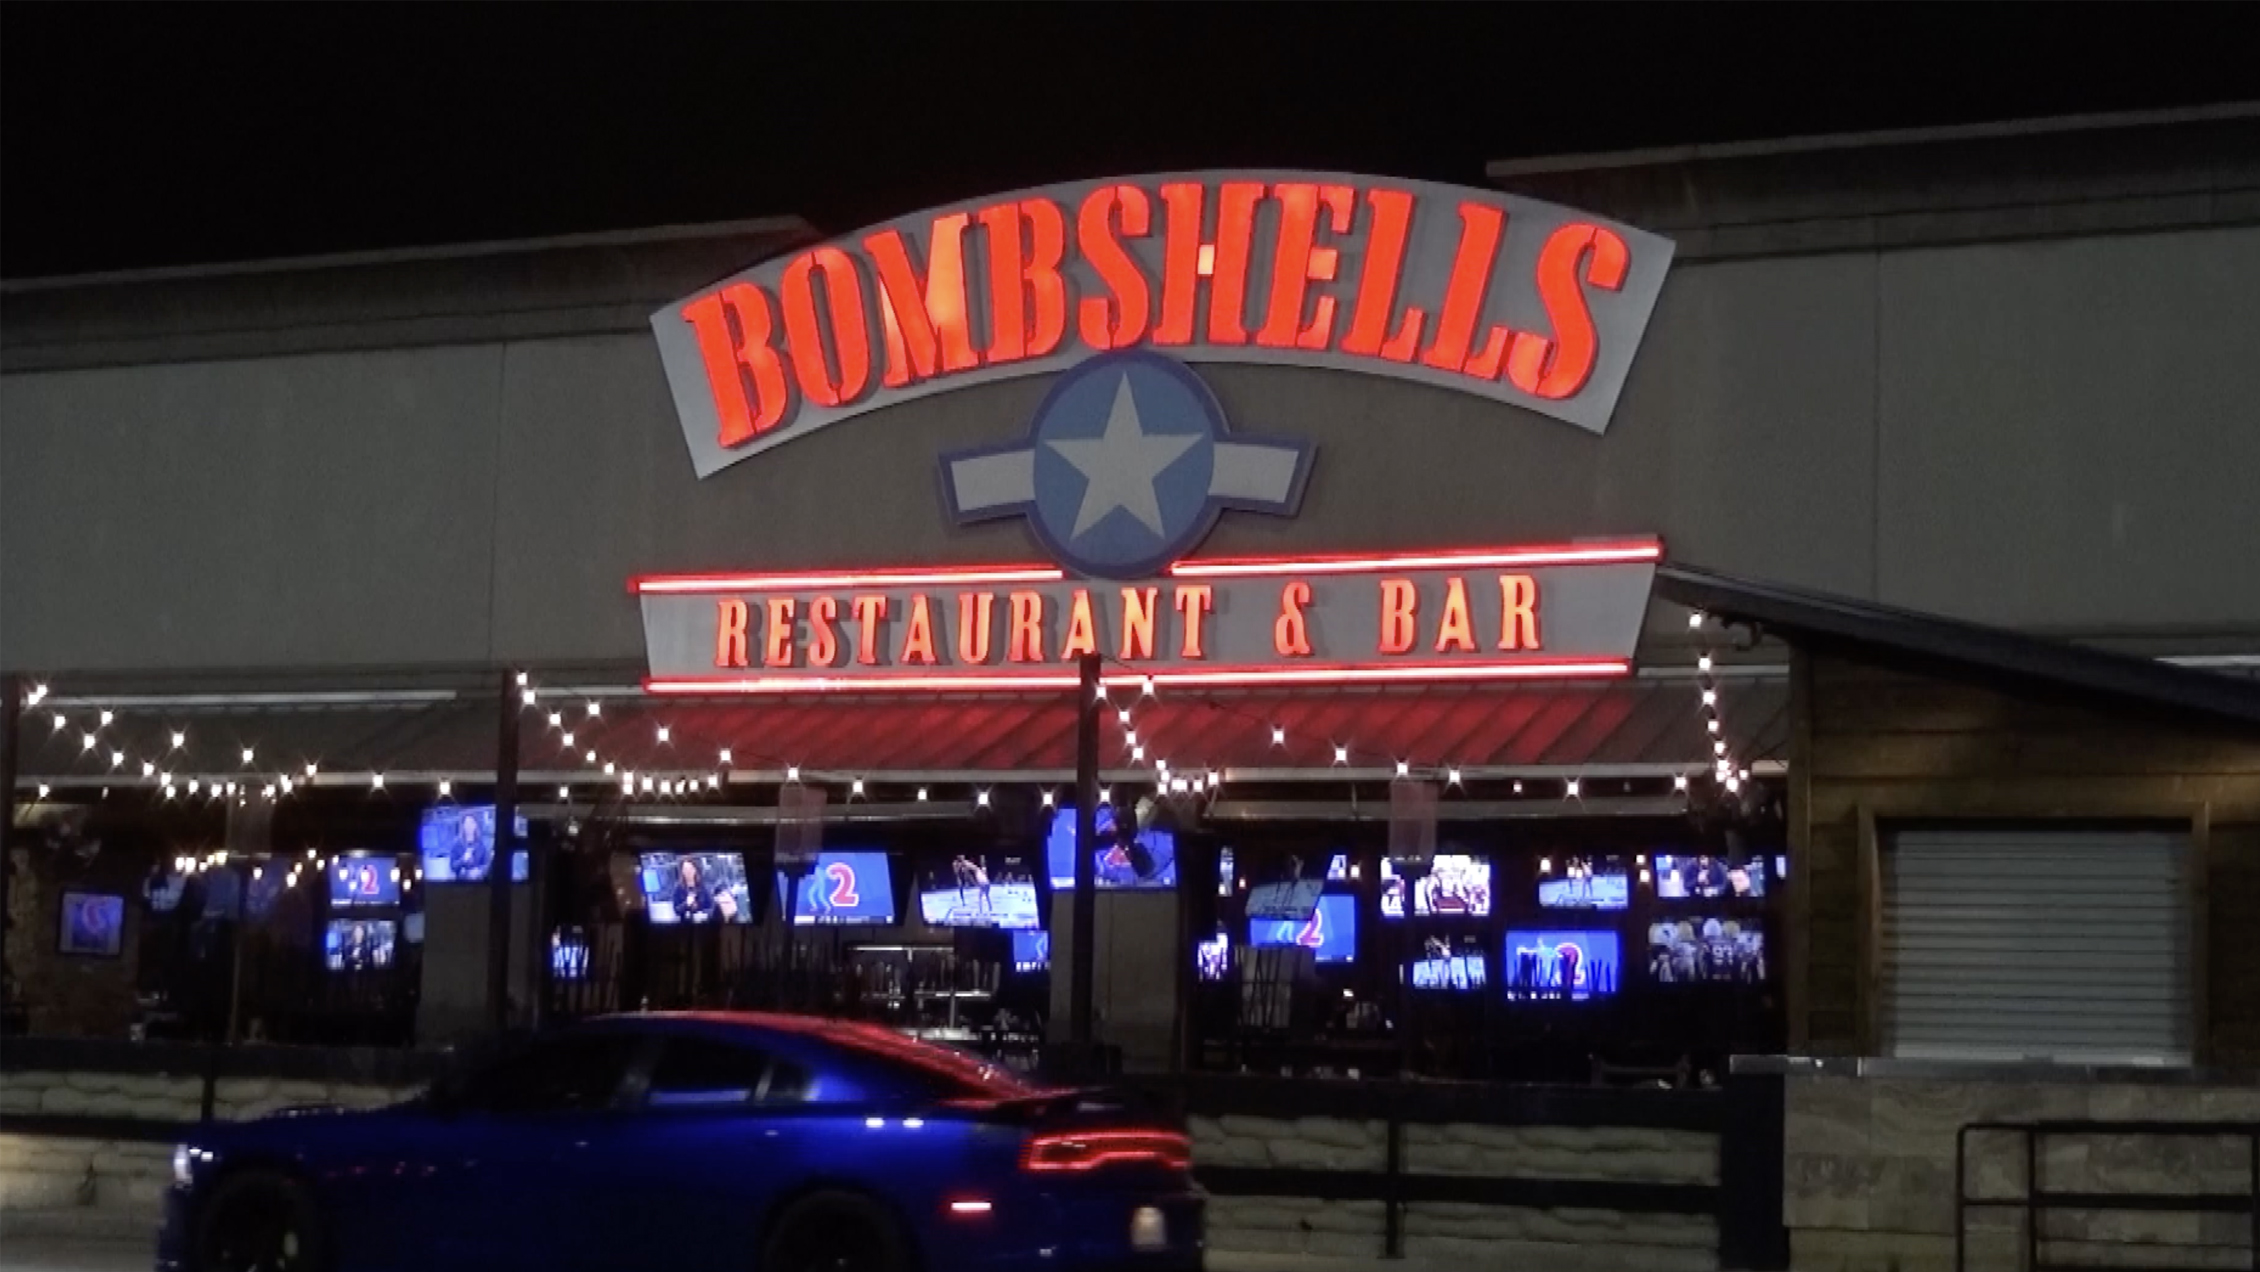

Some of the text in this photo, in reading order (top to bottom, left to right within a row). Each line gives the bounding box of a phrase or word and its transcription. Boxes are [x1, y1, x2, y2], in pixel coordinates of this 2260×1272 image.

[682, 180, 1628, 448] BOMBSHELLS
[714, 573, 1542, 669] RESTAURANT & BAR
[359, 865, 380, 894] 2
[826, 862, 859, 906] 2
